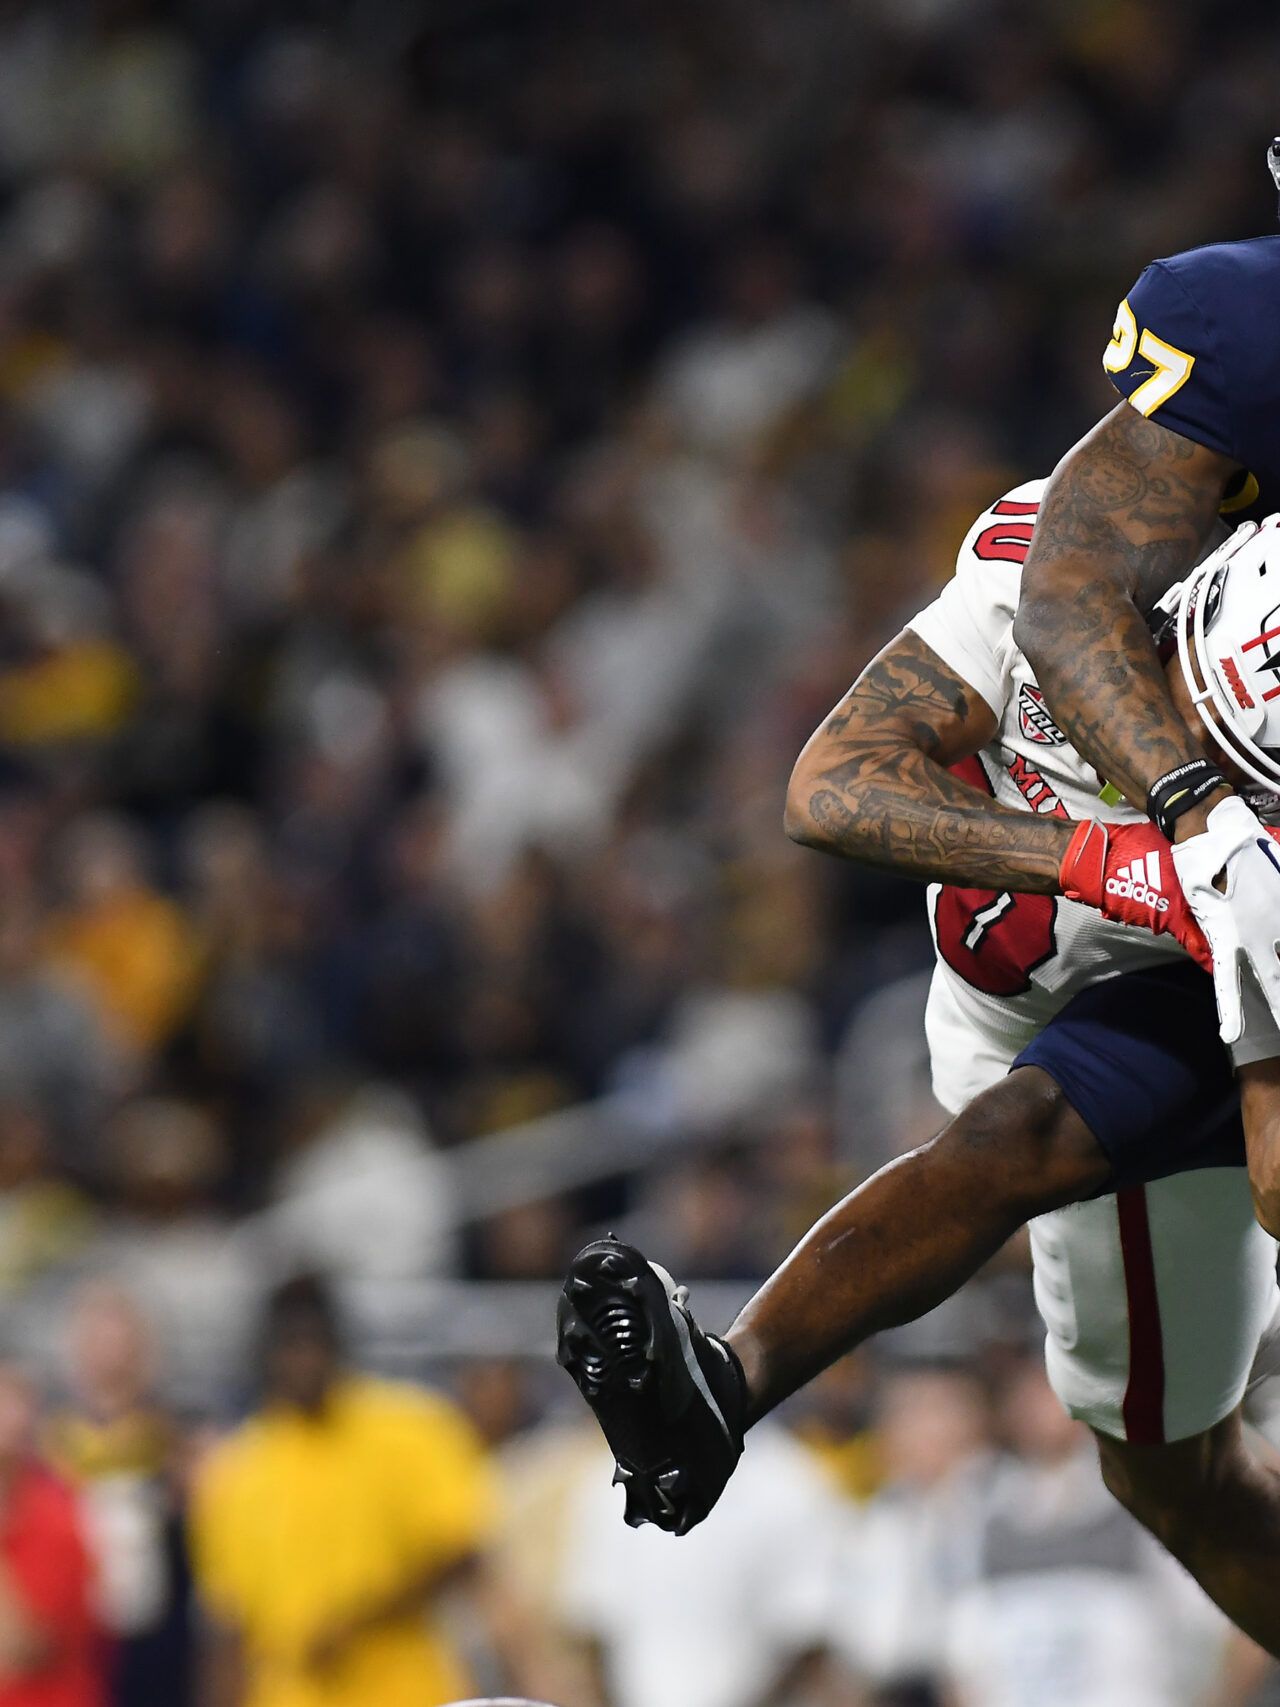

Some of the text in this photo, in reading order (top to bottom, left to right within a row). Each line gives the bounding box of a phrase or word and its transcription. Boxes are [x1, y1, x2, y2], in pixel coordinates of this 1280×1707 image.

[1019, 694, 1068, 745] MAC
[1150, 760, 1207, 797] #mentalhealth
[1106, 877, 1170, 912] adidas
